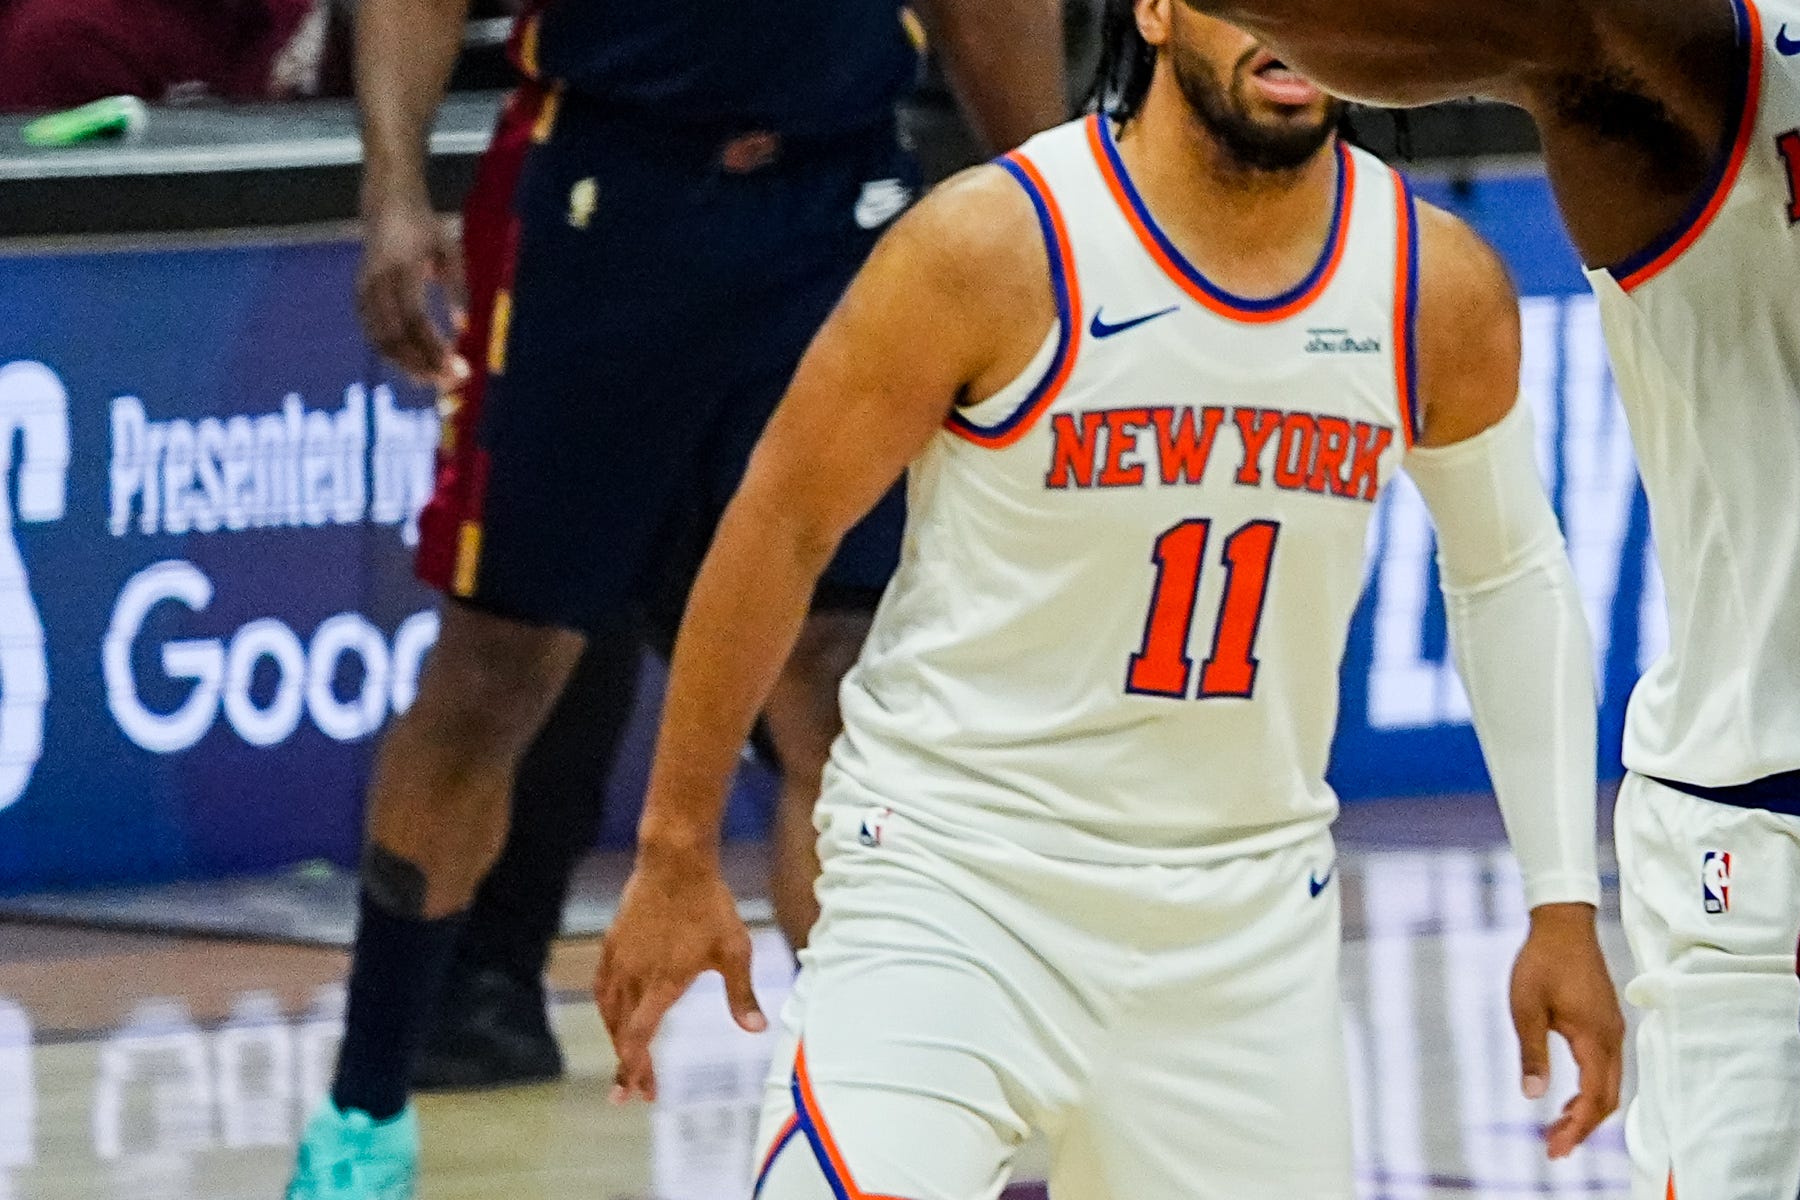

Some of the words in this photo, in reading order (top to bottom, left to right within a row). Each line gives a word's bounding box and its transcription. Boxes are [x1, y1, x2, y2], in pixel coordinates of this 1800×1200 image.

[109, 381, 367, 537] Presented
[371, 383, 441, 547] by
[1045, 405, 1224, 489] NEW
[1233, 406, 1394, 502] YORK
[1124, 516, 1280, 700] 11
